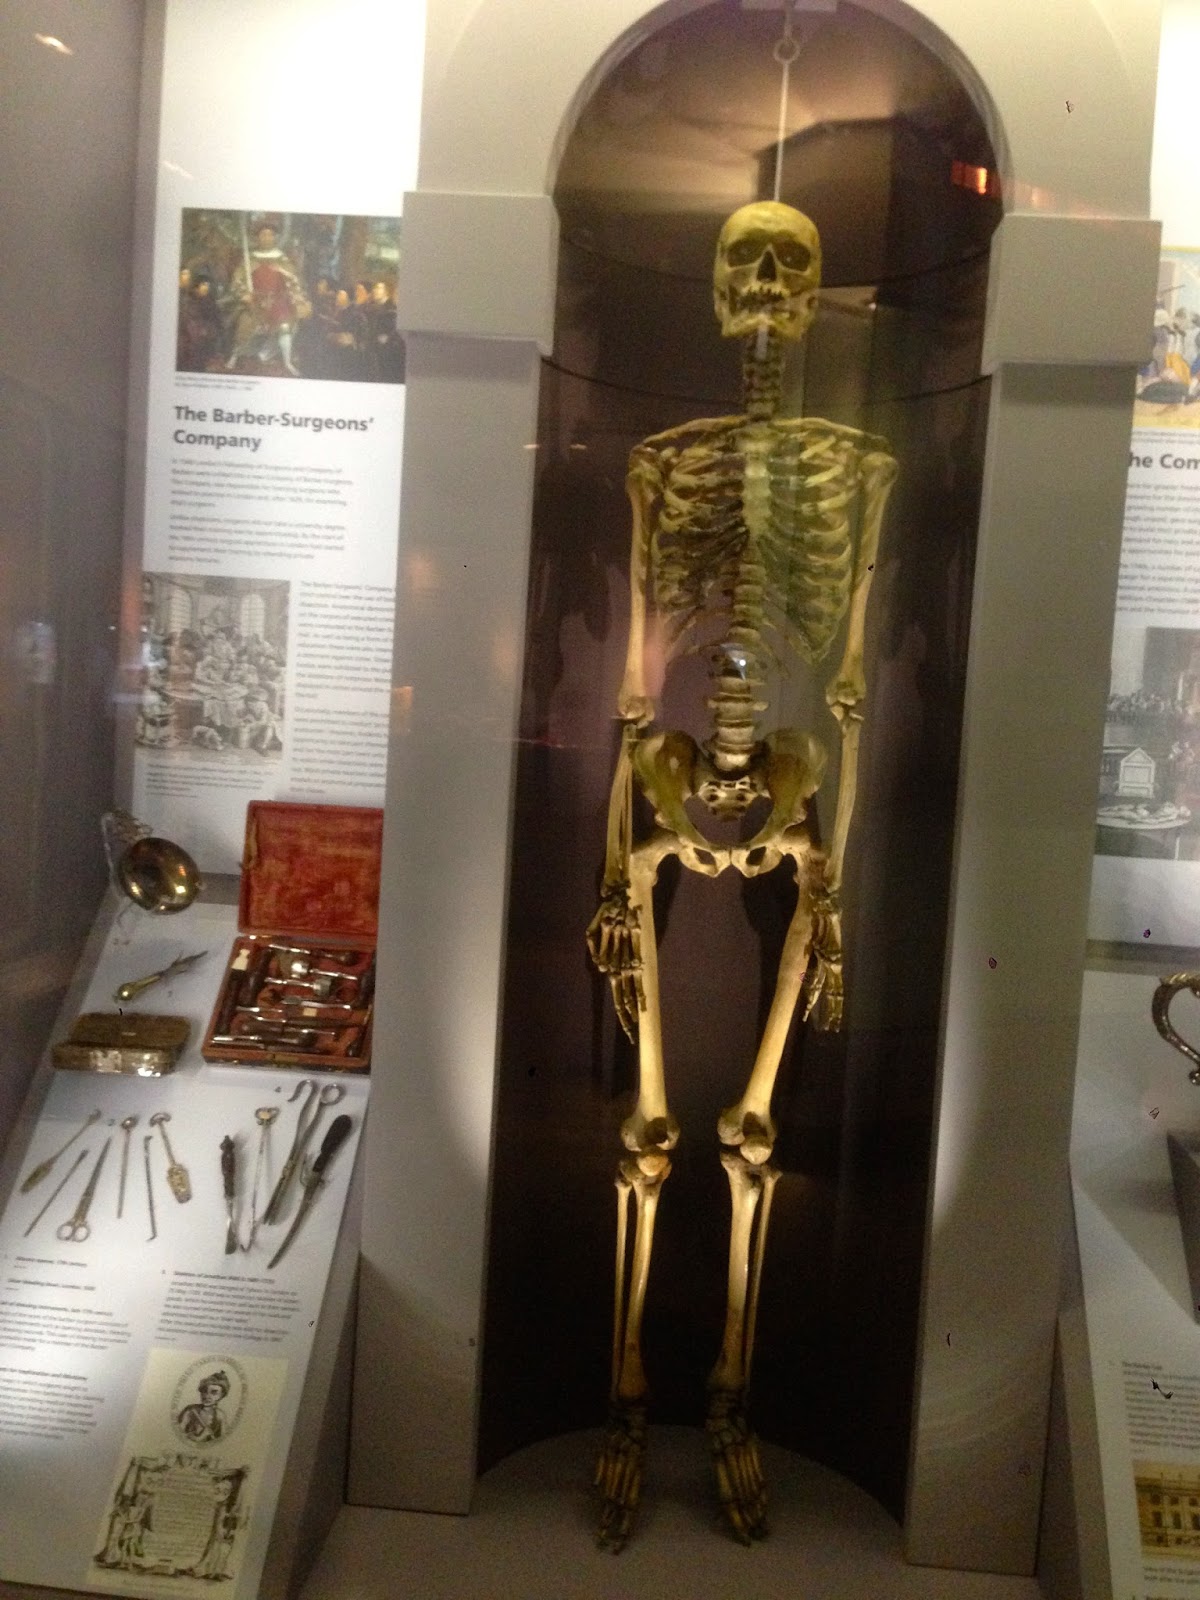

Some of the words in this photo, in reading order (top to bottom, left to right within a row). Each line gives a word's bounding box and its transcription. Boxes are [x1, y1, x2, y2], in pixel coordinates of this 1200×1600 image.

[174, 405, 207, 421] The
[173, 429, 262, 452] Company
[1128, 452, 1153, 468] he
